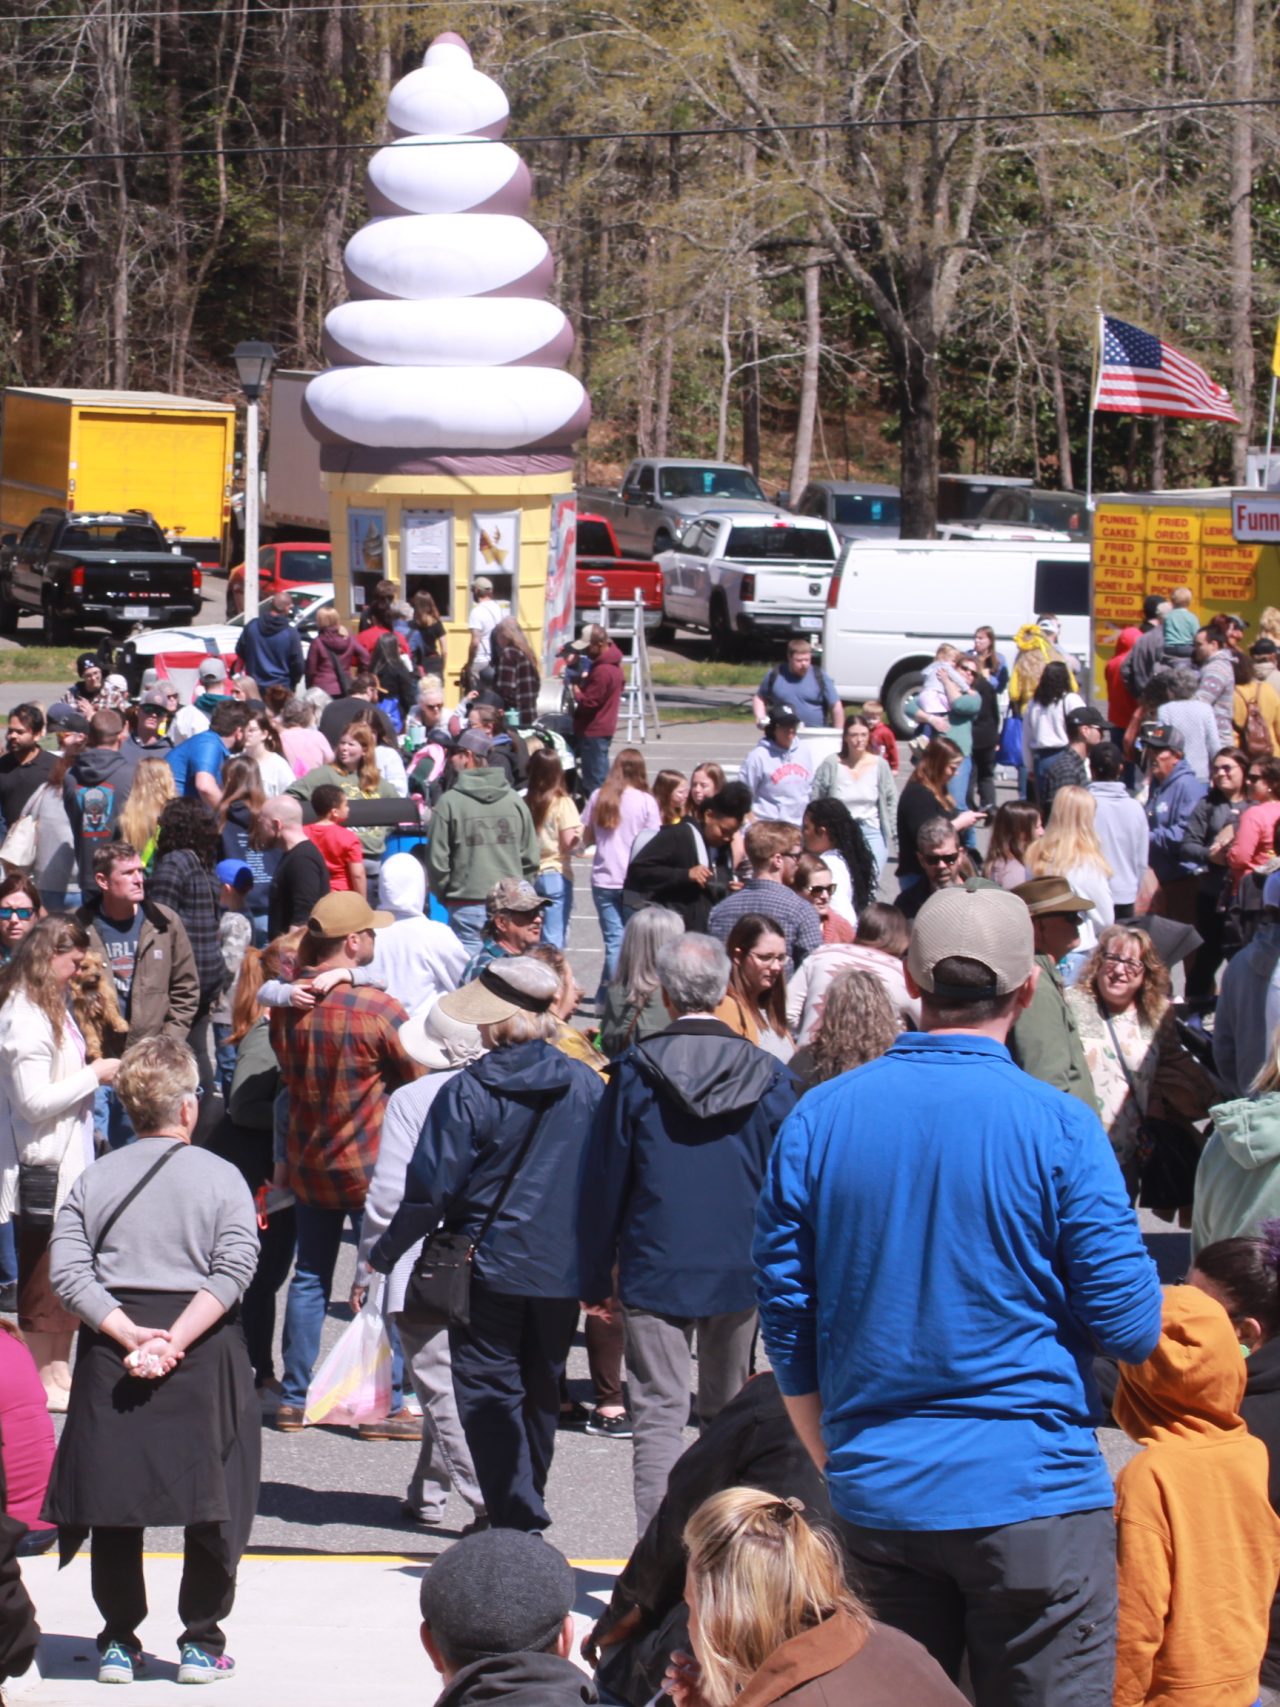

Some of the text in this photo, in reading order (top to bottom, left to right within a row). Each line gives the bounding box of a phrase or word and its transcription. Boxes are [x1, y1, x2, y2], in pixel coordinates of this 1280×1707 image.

[1099, 515, 1139, 526] FUNNEL
[1158, 517, 1189, 527] FRIED
[1102, 528, 1136, 538] CAKES
[1155, 530, 1190, 540] OREOS
[1104, 543, 1134, 552] FRIED
[1157, 545, 1188, 555] FRIED
[1237, 549, 1253, 558] TEA
[1151, 558, 1193, 569] TWINKIE
[1104, 569, 1134, 579] FRIED
[1157, 574, 1187, 583] FRIED
[1206, 576, 1253, 586] BOTTLED
[1211, 588, 1247, 598] WATER
[1104, 596, 1135, 606] FRIED
